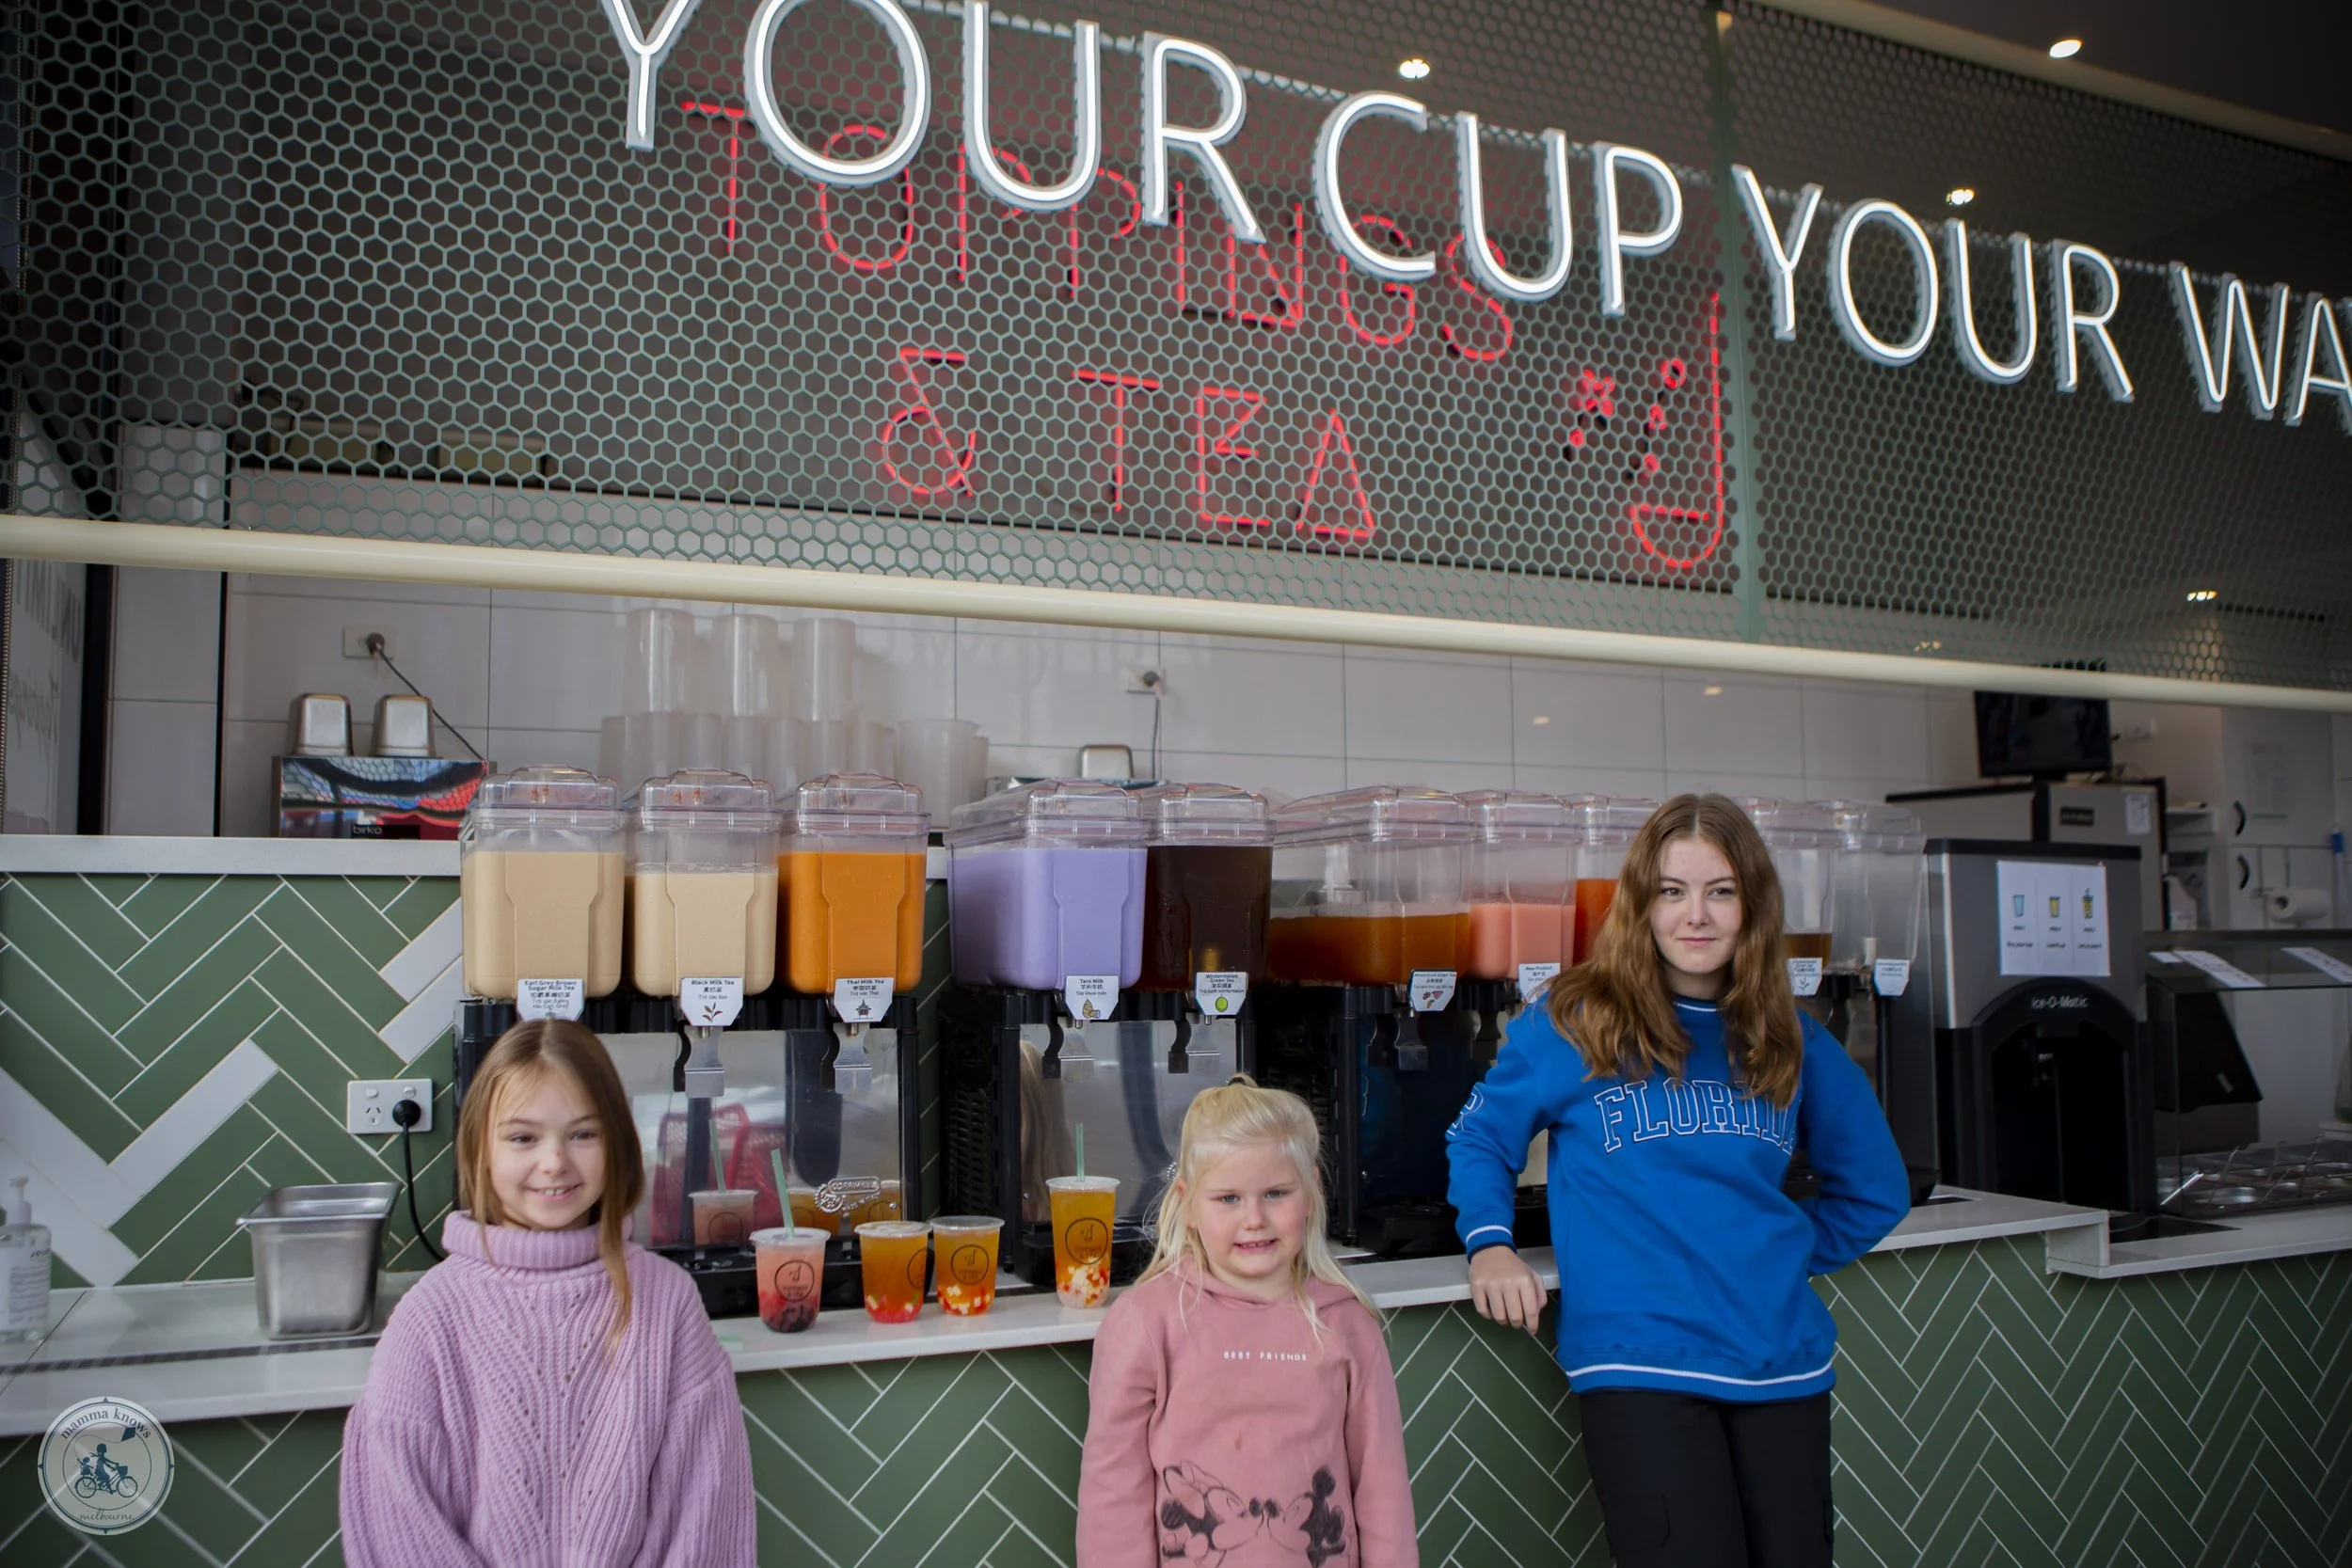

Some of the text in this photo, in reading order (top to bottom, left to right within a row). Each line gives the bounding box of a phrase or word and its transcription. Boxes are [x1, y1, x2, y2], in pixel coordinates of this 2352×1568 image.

[602, 0, 2352, 436] YOUR CUP YOUR WA
[1073, 370, 1376, 538] TEA
[1595, 1077, 1803, 1156] FLORID
[1224, 1350, 1307, 1361] BEST FRIENDS
